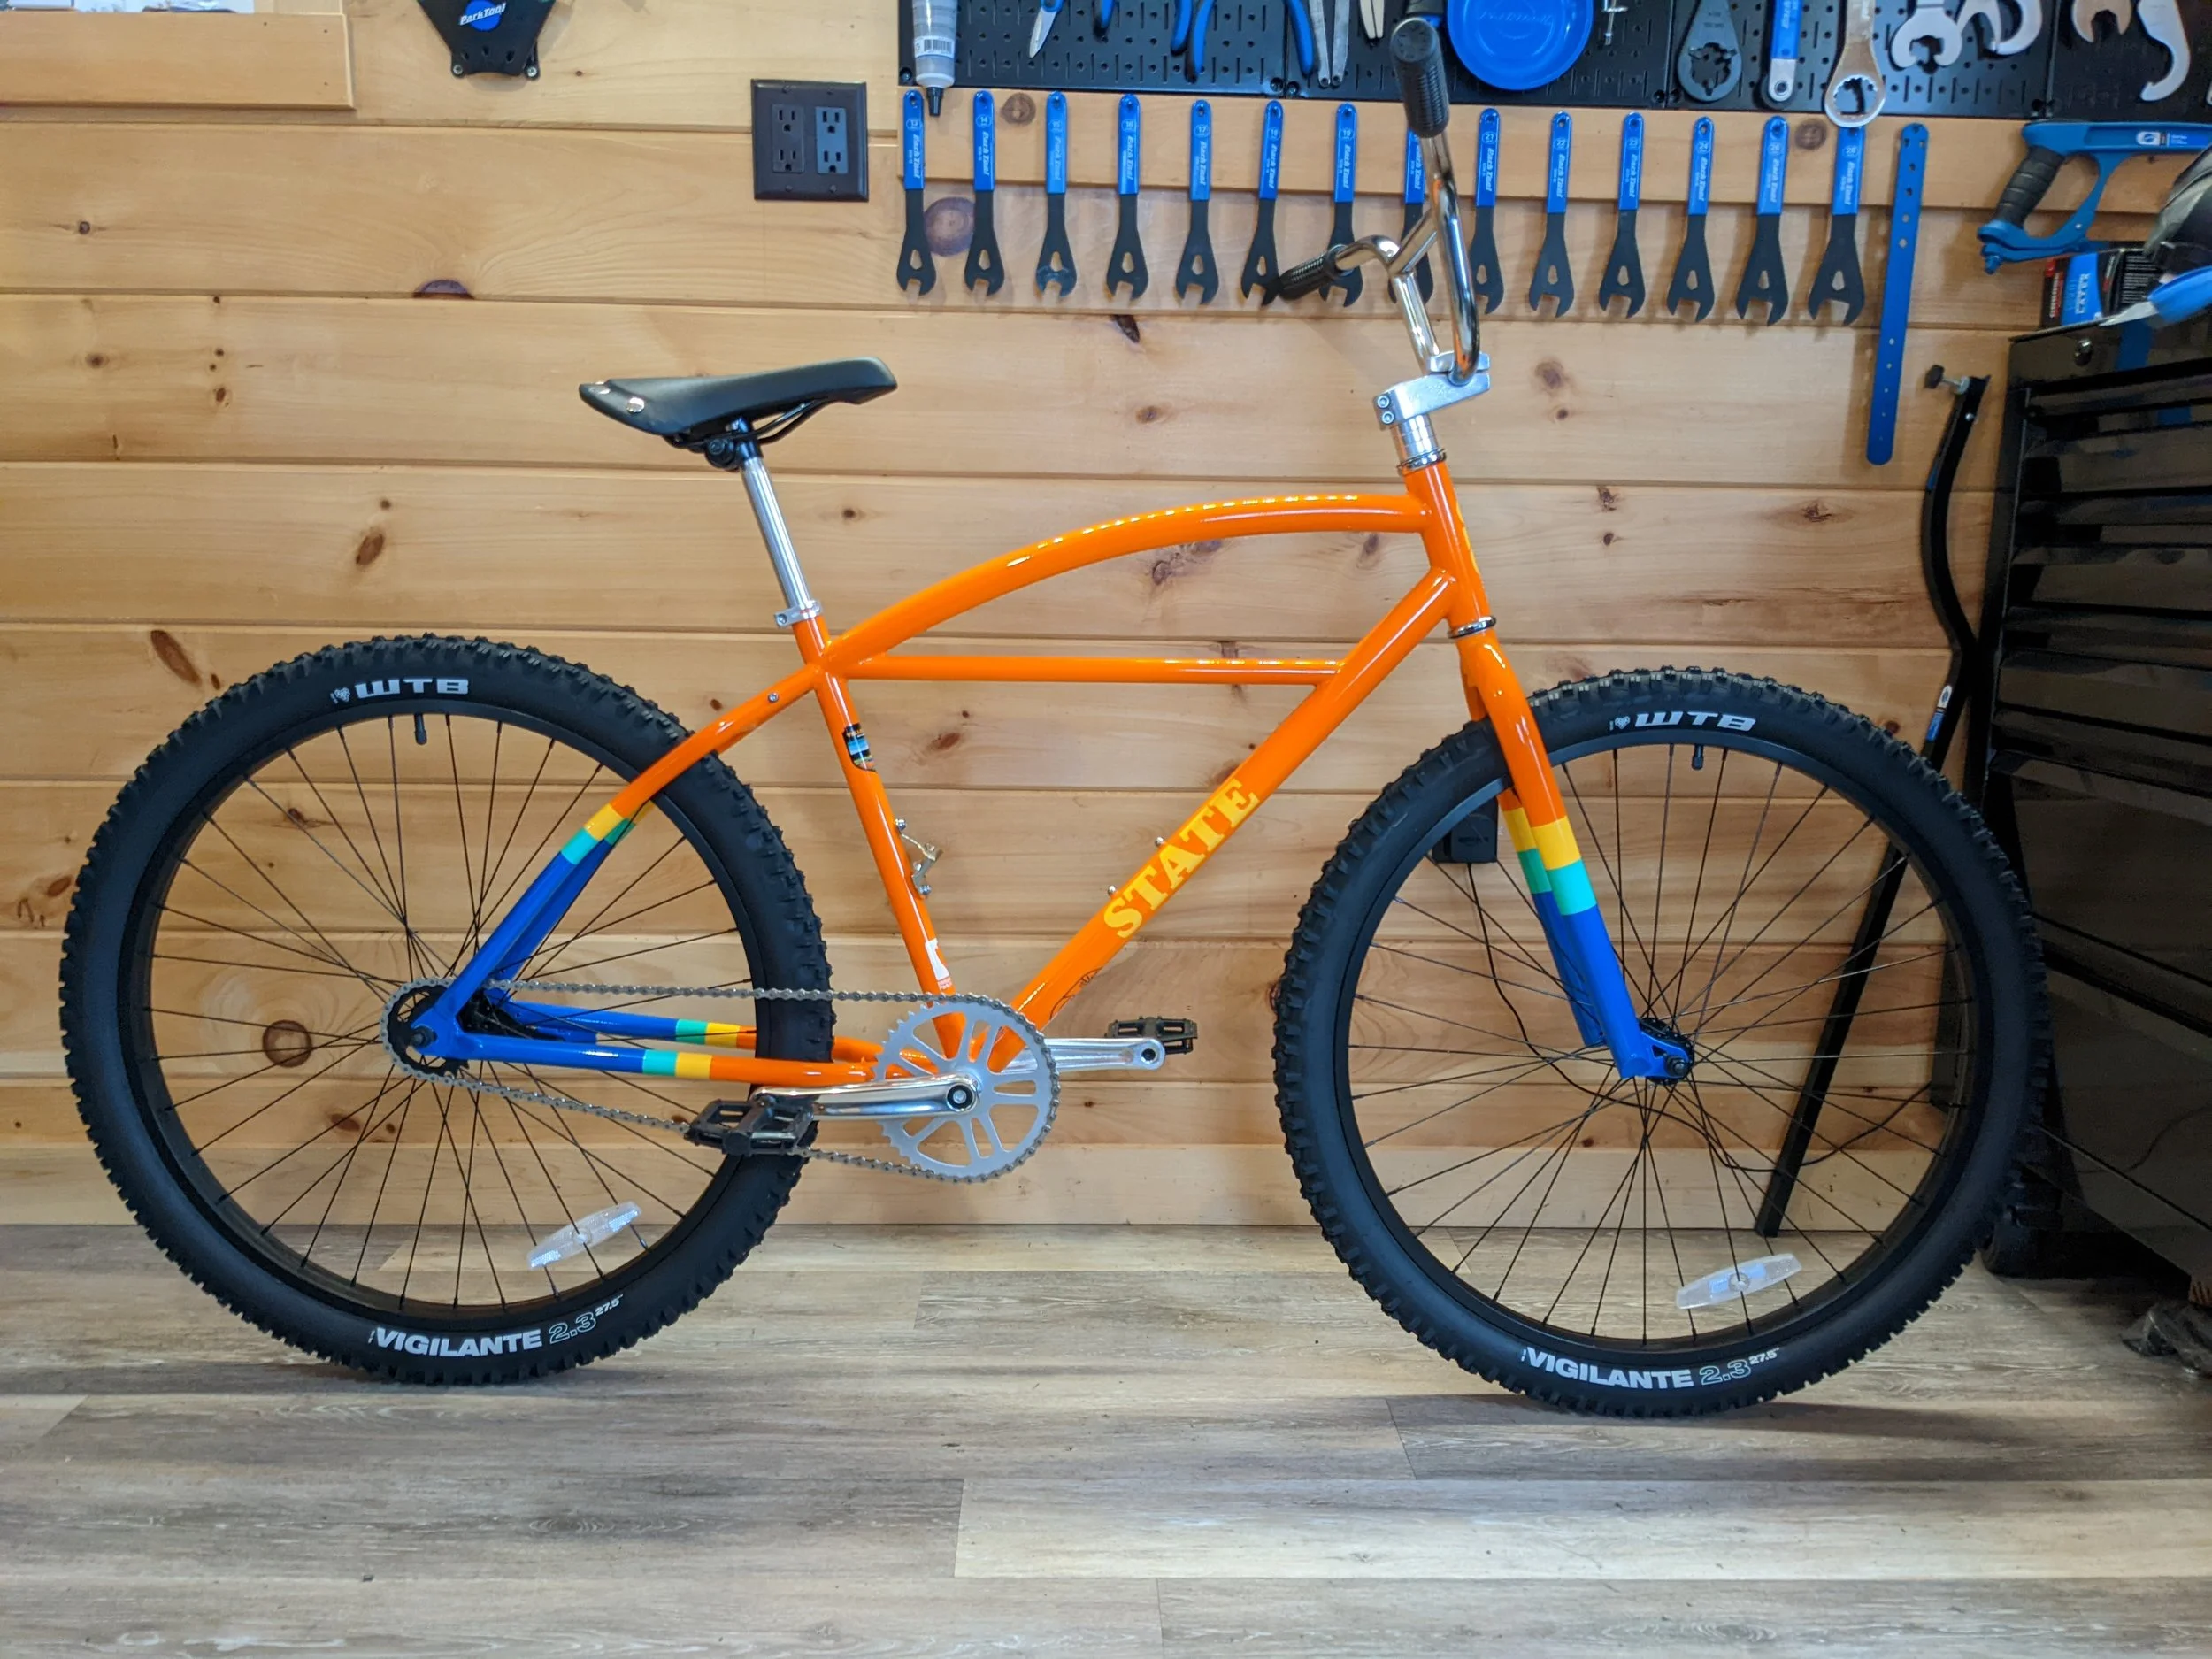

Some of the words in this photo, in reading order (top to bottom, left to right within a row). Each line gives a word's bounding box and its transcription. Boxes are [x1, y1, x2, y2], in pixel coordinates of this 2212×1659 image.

[354, 678, 469, 699] WTB
[1635, 711, 1756, 732] WTB
[1103, 778, 1261, 939] STATE
[376, 1327, 542, 1356] VIGILANTE
[549, 1311, 597, 1344] 2.3
[1526, 1346, 1694, 1389] VIGILANTE
[1699, 1359, 1752, 1386] 2.3
